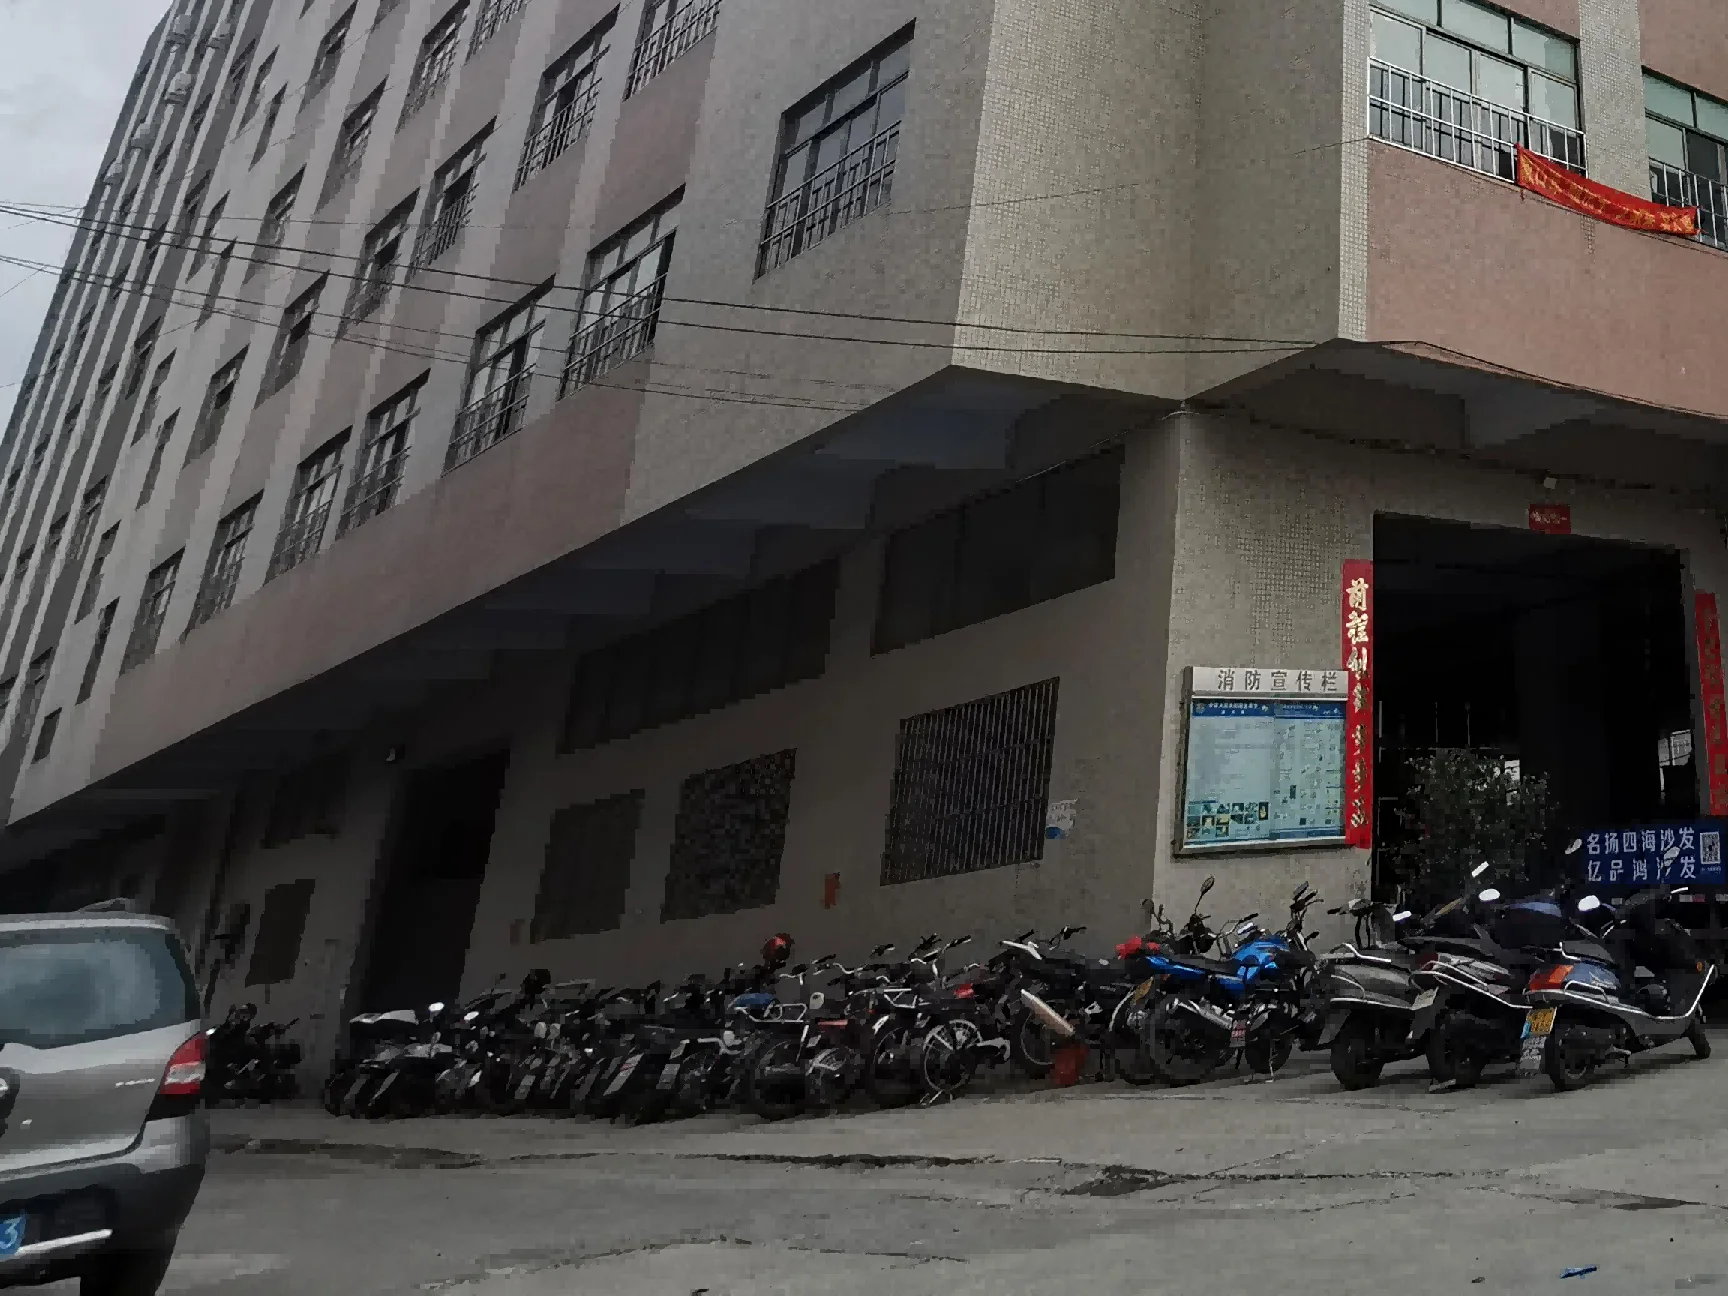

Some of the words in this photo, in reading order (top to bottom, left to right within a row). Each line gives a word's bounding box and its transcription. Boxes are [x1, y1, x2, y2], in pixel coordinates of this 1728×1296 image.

[1216, 668, 1338, 692] 消防宣传栏
[1586, 826, 1695, 855] 名扬四海沙发
